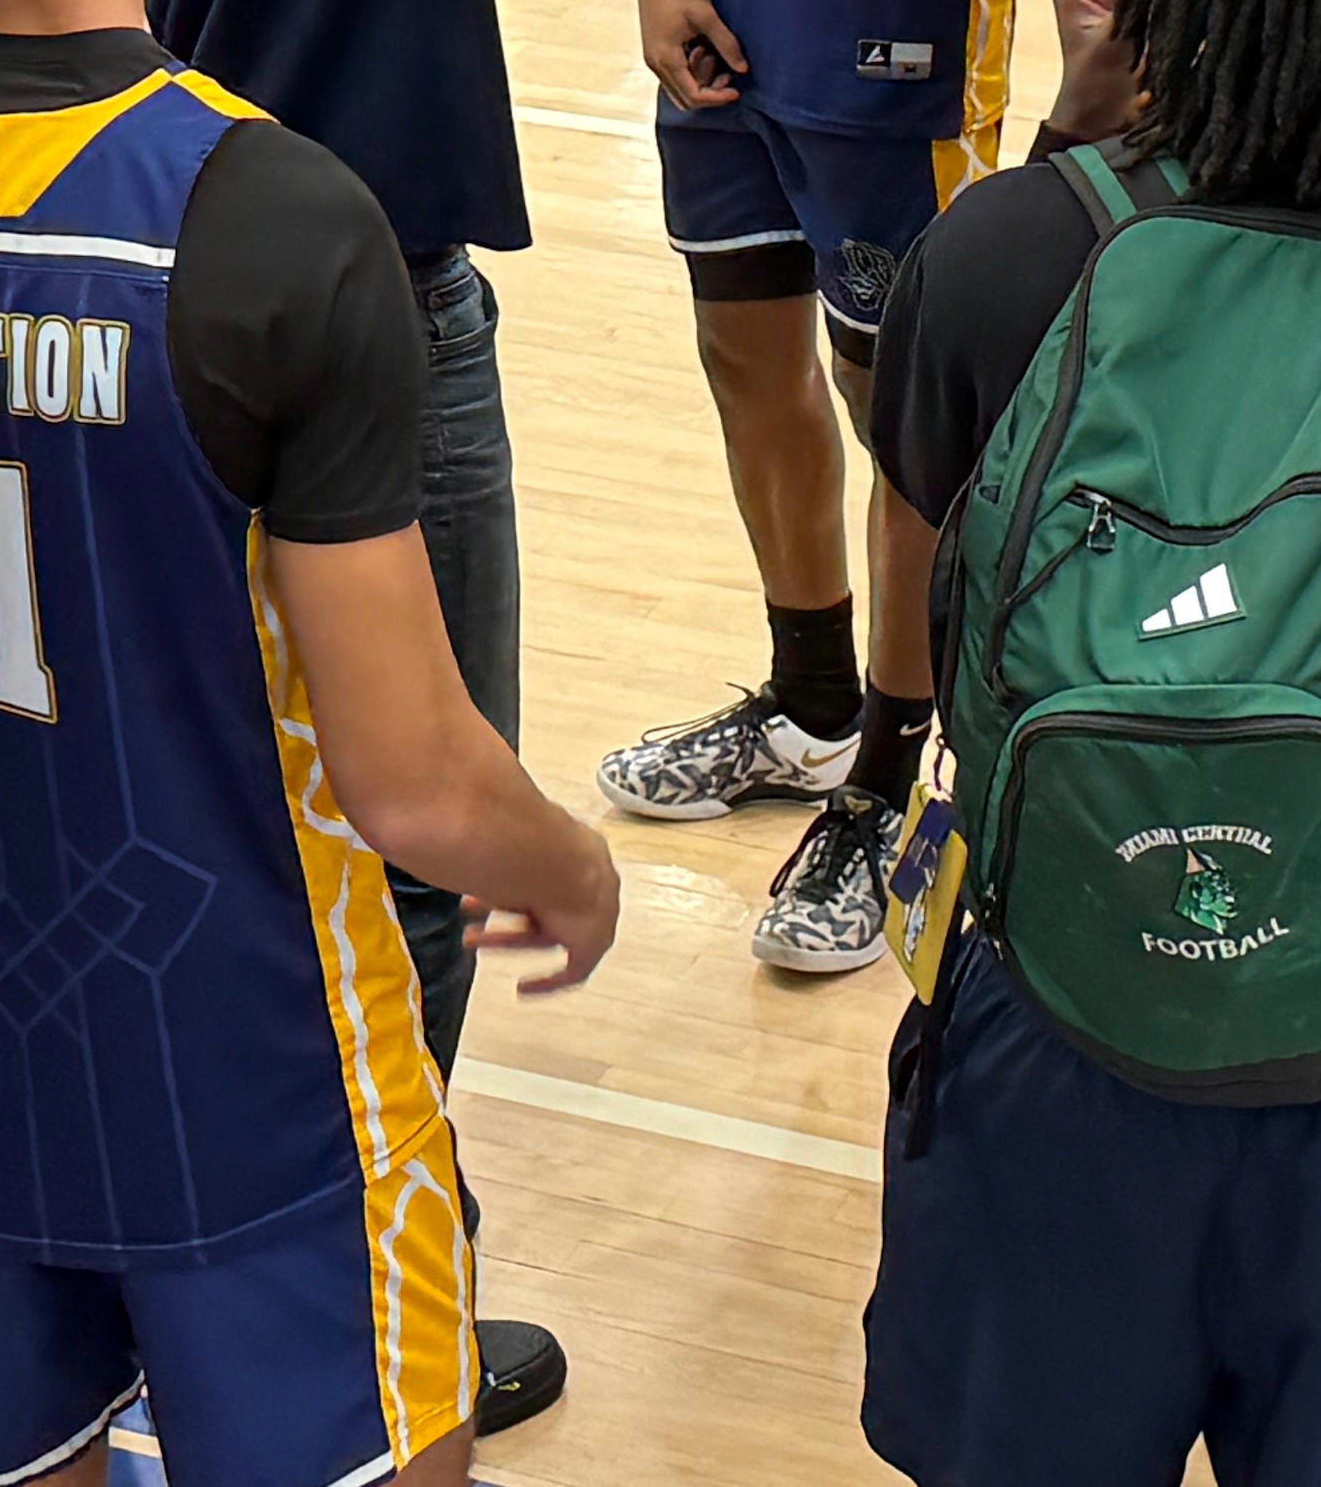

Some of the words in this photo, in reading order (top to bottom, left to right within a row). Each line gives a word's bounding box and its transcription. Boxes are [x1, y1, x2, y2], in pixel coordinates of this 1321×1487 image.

[1115, 827, 1179, 863] MIAMI
[1181, 825, 1273, 855] CENTRAL
[1141, 917, 1290, 961] FOOTBALL
